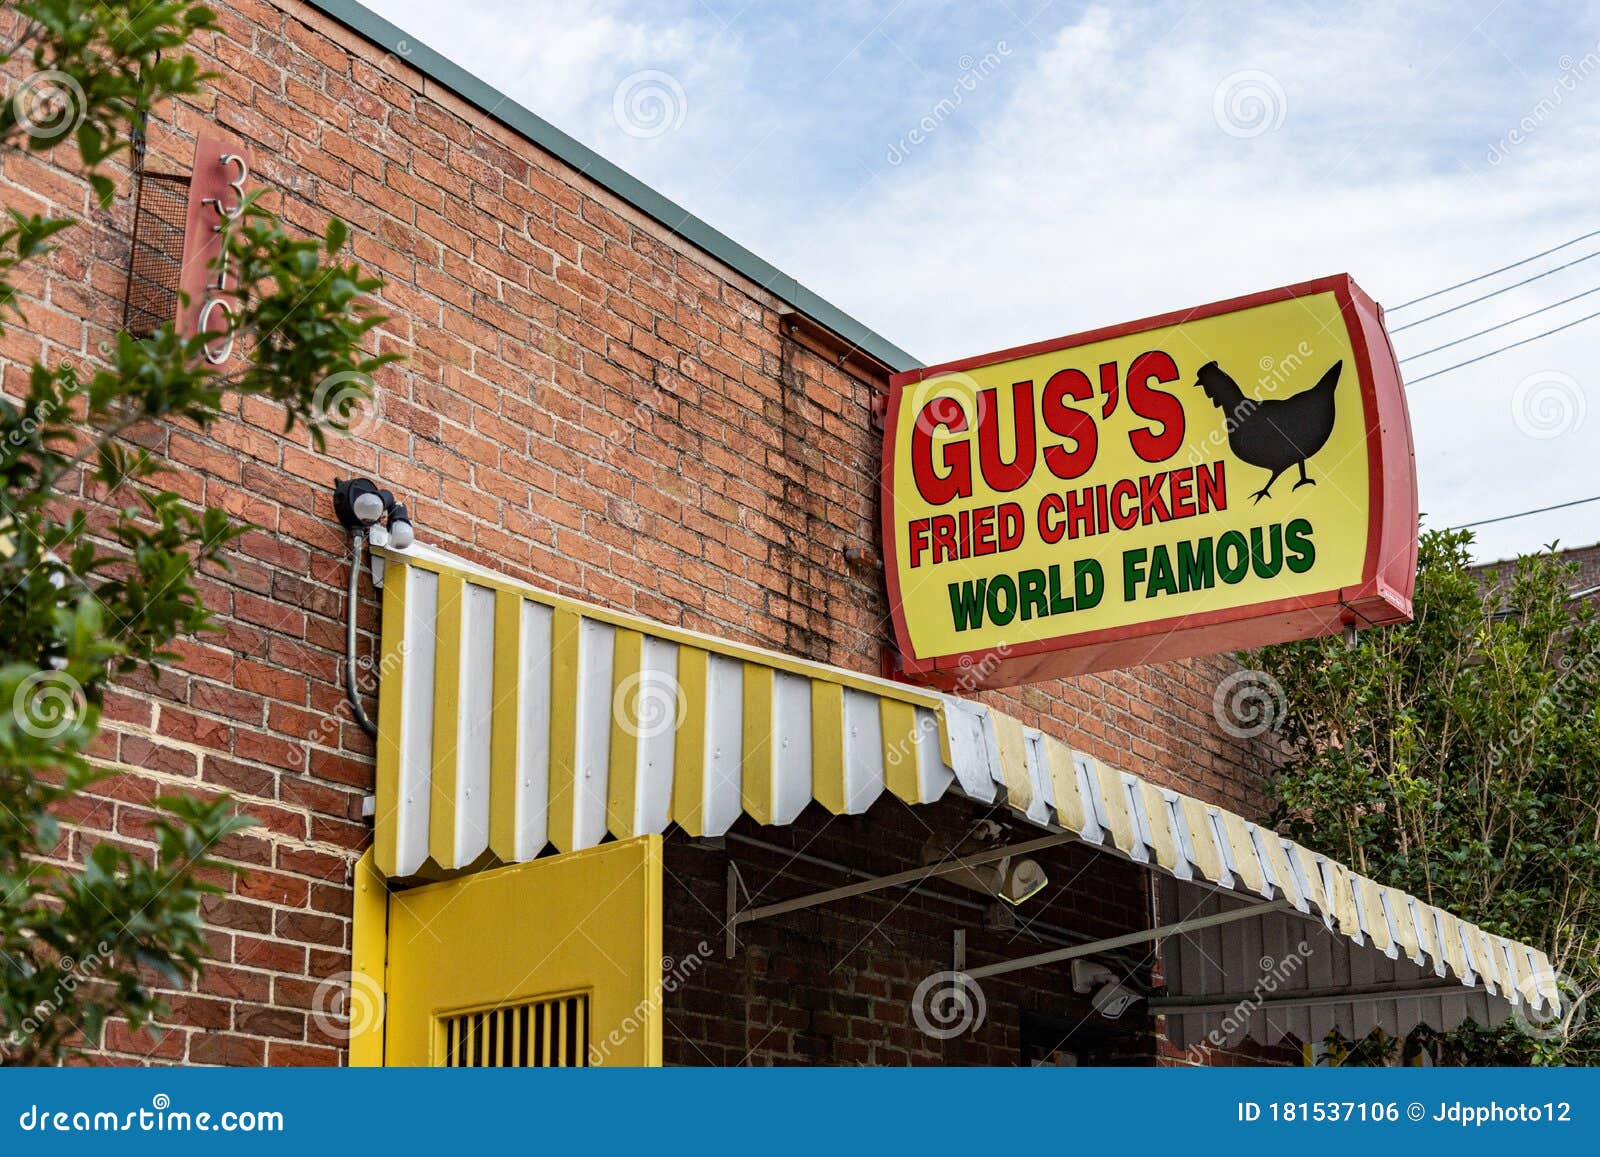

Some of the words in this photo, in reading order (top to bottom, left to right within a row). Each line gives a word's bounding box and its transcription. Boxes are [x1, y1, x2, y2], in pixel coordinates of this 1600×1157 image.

[911, 350, 1186, 506] GUS'S
[908, 509, 1025, 569] FRIED
[1037, 460, 1228, 545] CHICKEN
[947, 558, 1105, 632] WORLD
[1122, 518, 1316, 602] FAMOUS
